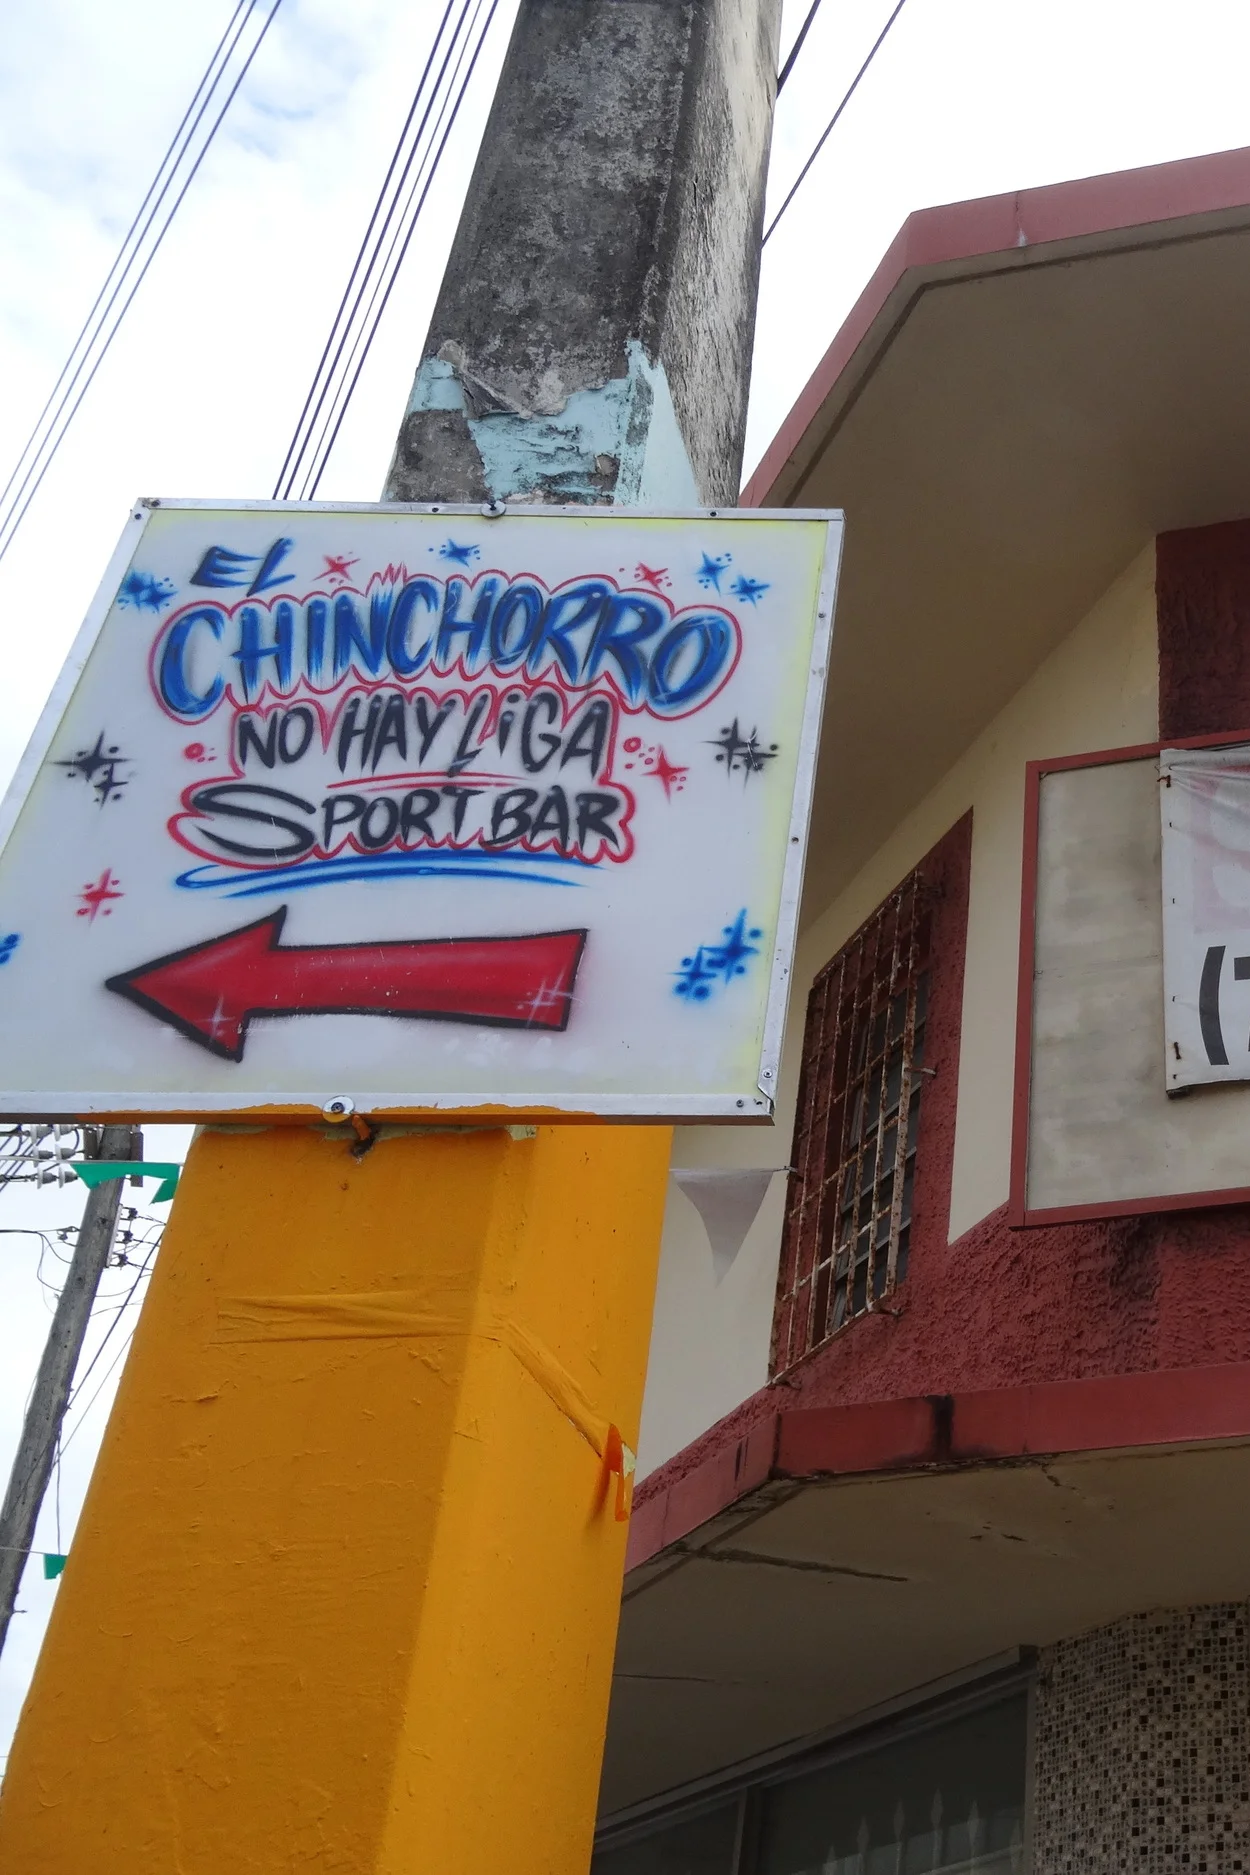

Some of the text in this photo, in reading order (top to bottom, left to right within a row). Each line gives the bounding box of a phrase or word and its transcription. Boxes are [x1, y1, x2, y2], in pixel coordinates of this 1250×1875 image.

[188, 537, 296, 598] EL
[159, 577, 736, 716] CHINCHORRO
[238, 707, 315, 769] NO
[337, 692, 458, 776] HAY
[191, 784, 622, 859] SPORT BAR
